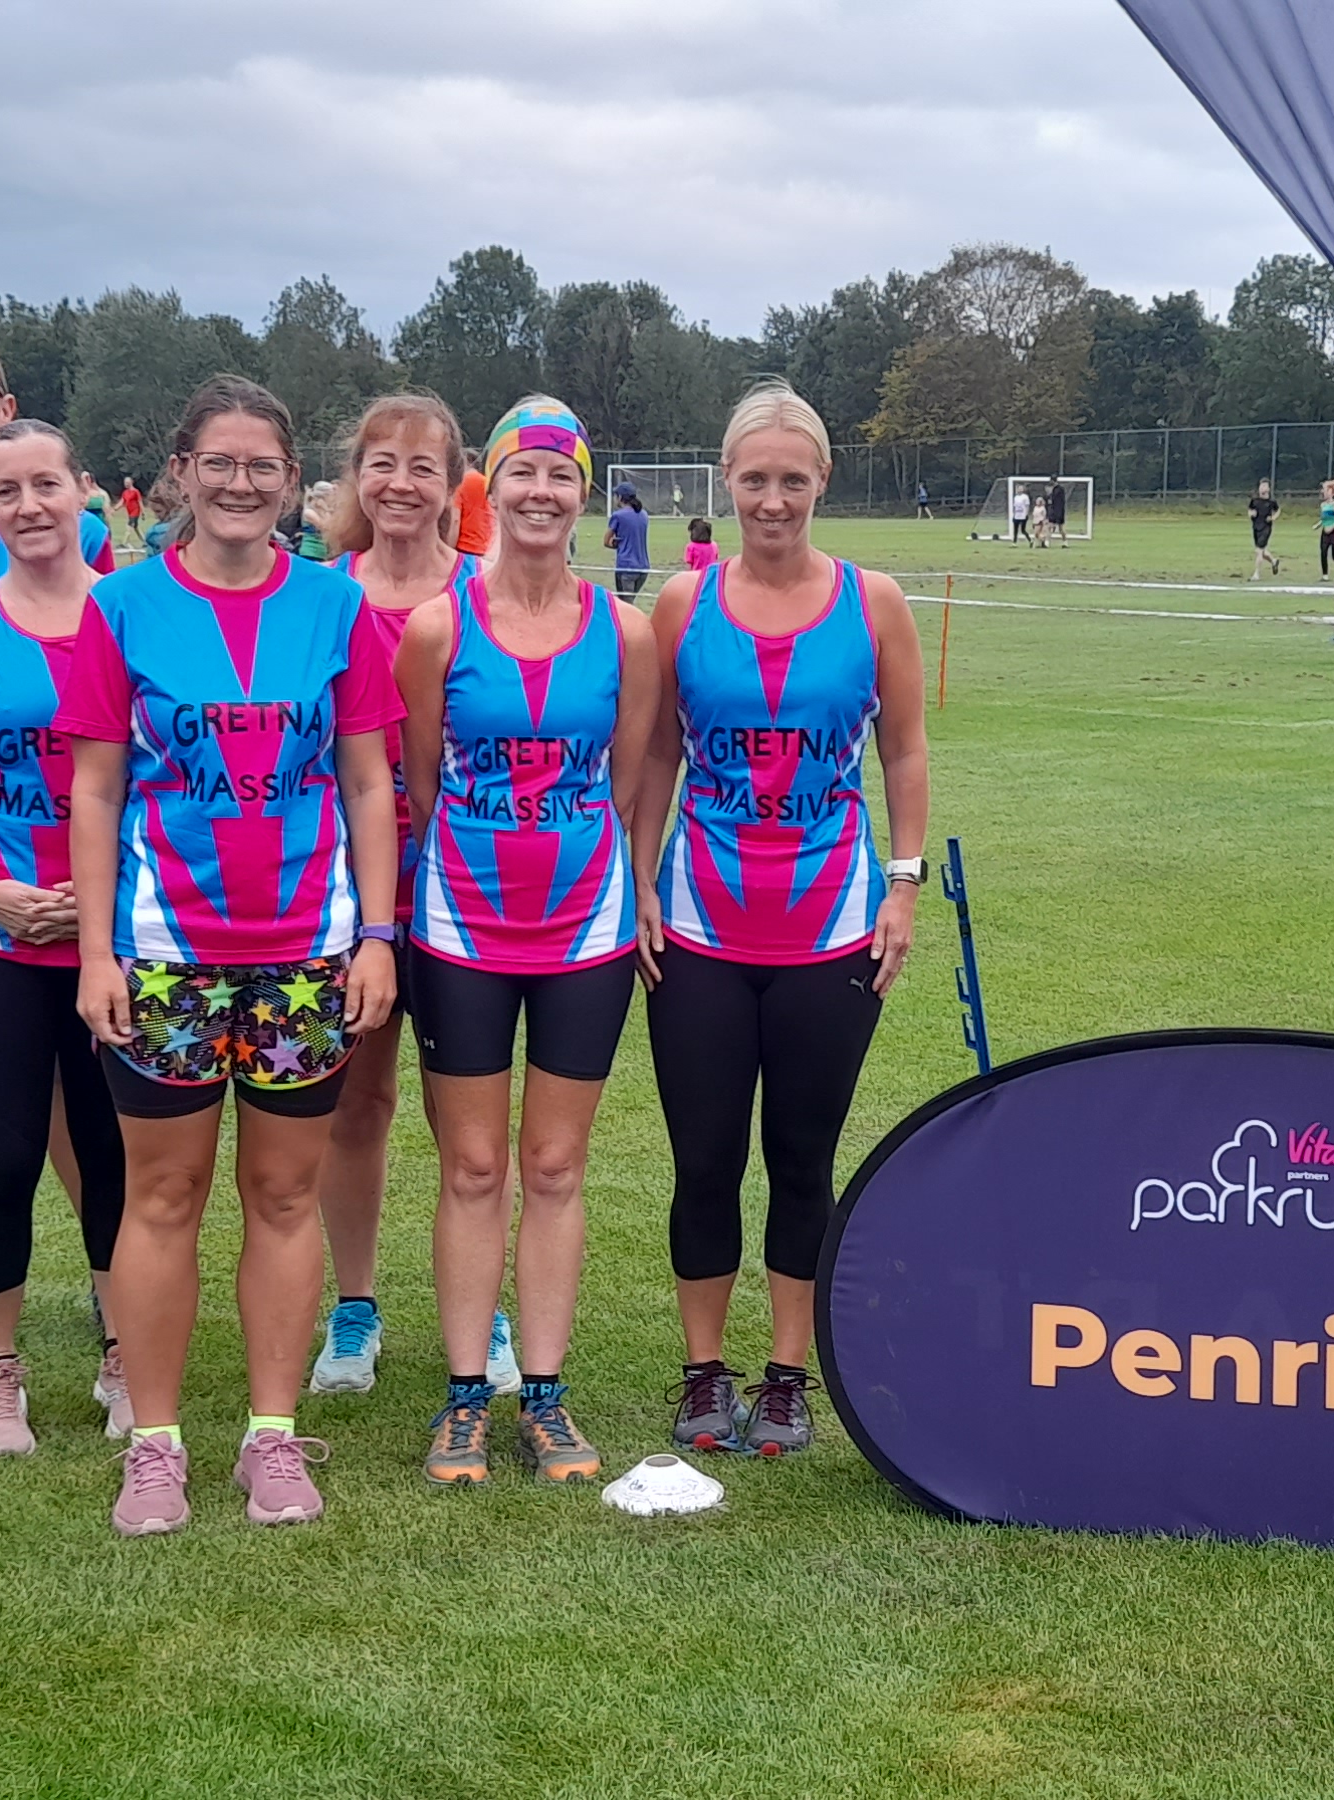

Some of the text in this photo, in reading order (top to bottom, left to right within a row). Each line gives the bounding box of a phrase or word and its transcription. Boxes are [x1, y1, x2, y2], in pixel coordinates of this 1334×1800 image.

[172, 701, 322, 747] GRETNA
[473, 737, 595, 781] GRETNA
[708, 726, 840, 771] GRETNA
[177, 753, 317, 802] MASSIVE
[708, 776, 842, 821] MASSIVE
[466, 780, 595, 823] MASSIVE
[1286, 1171, 1329, 1181] partners
